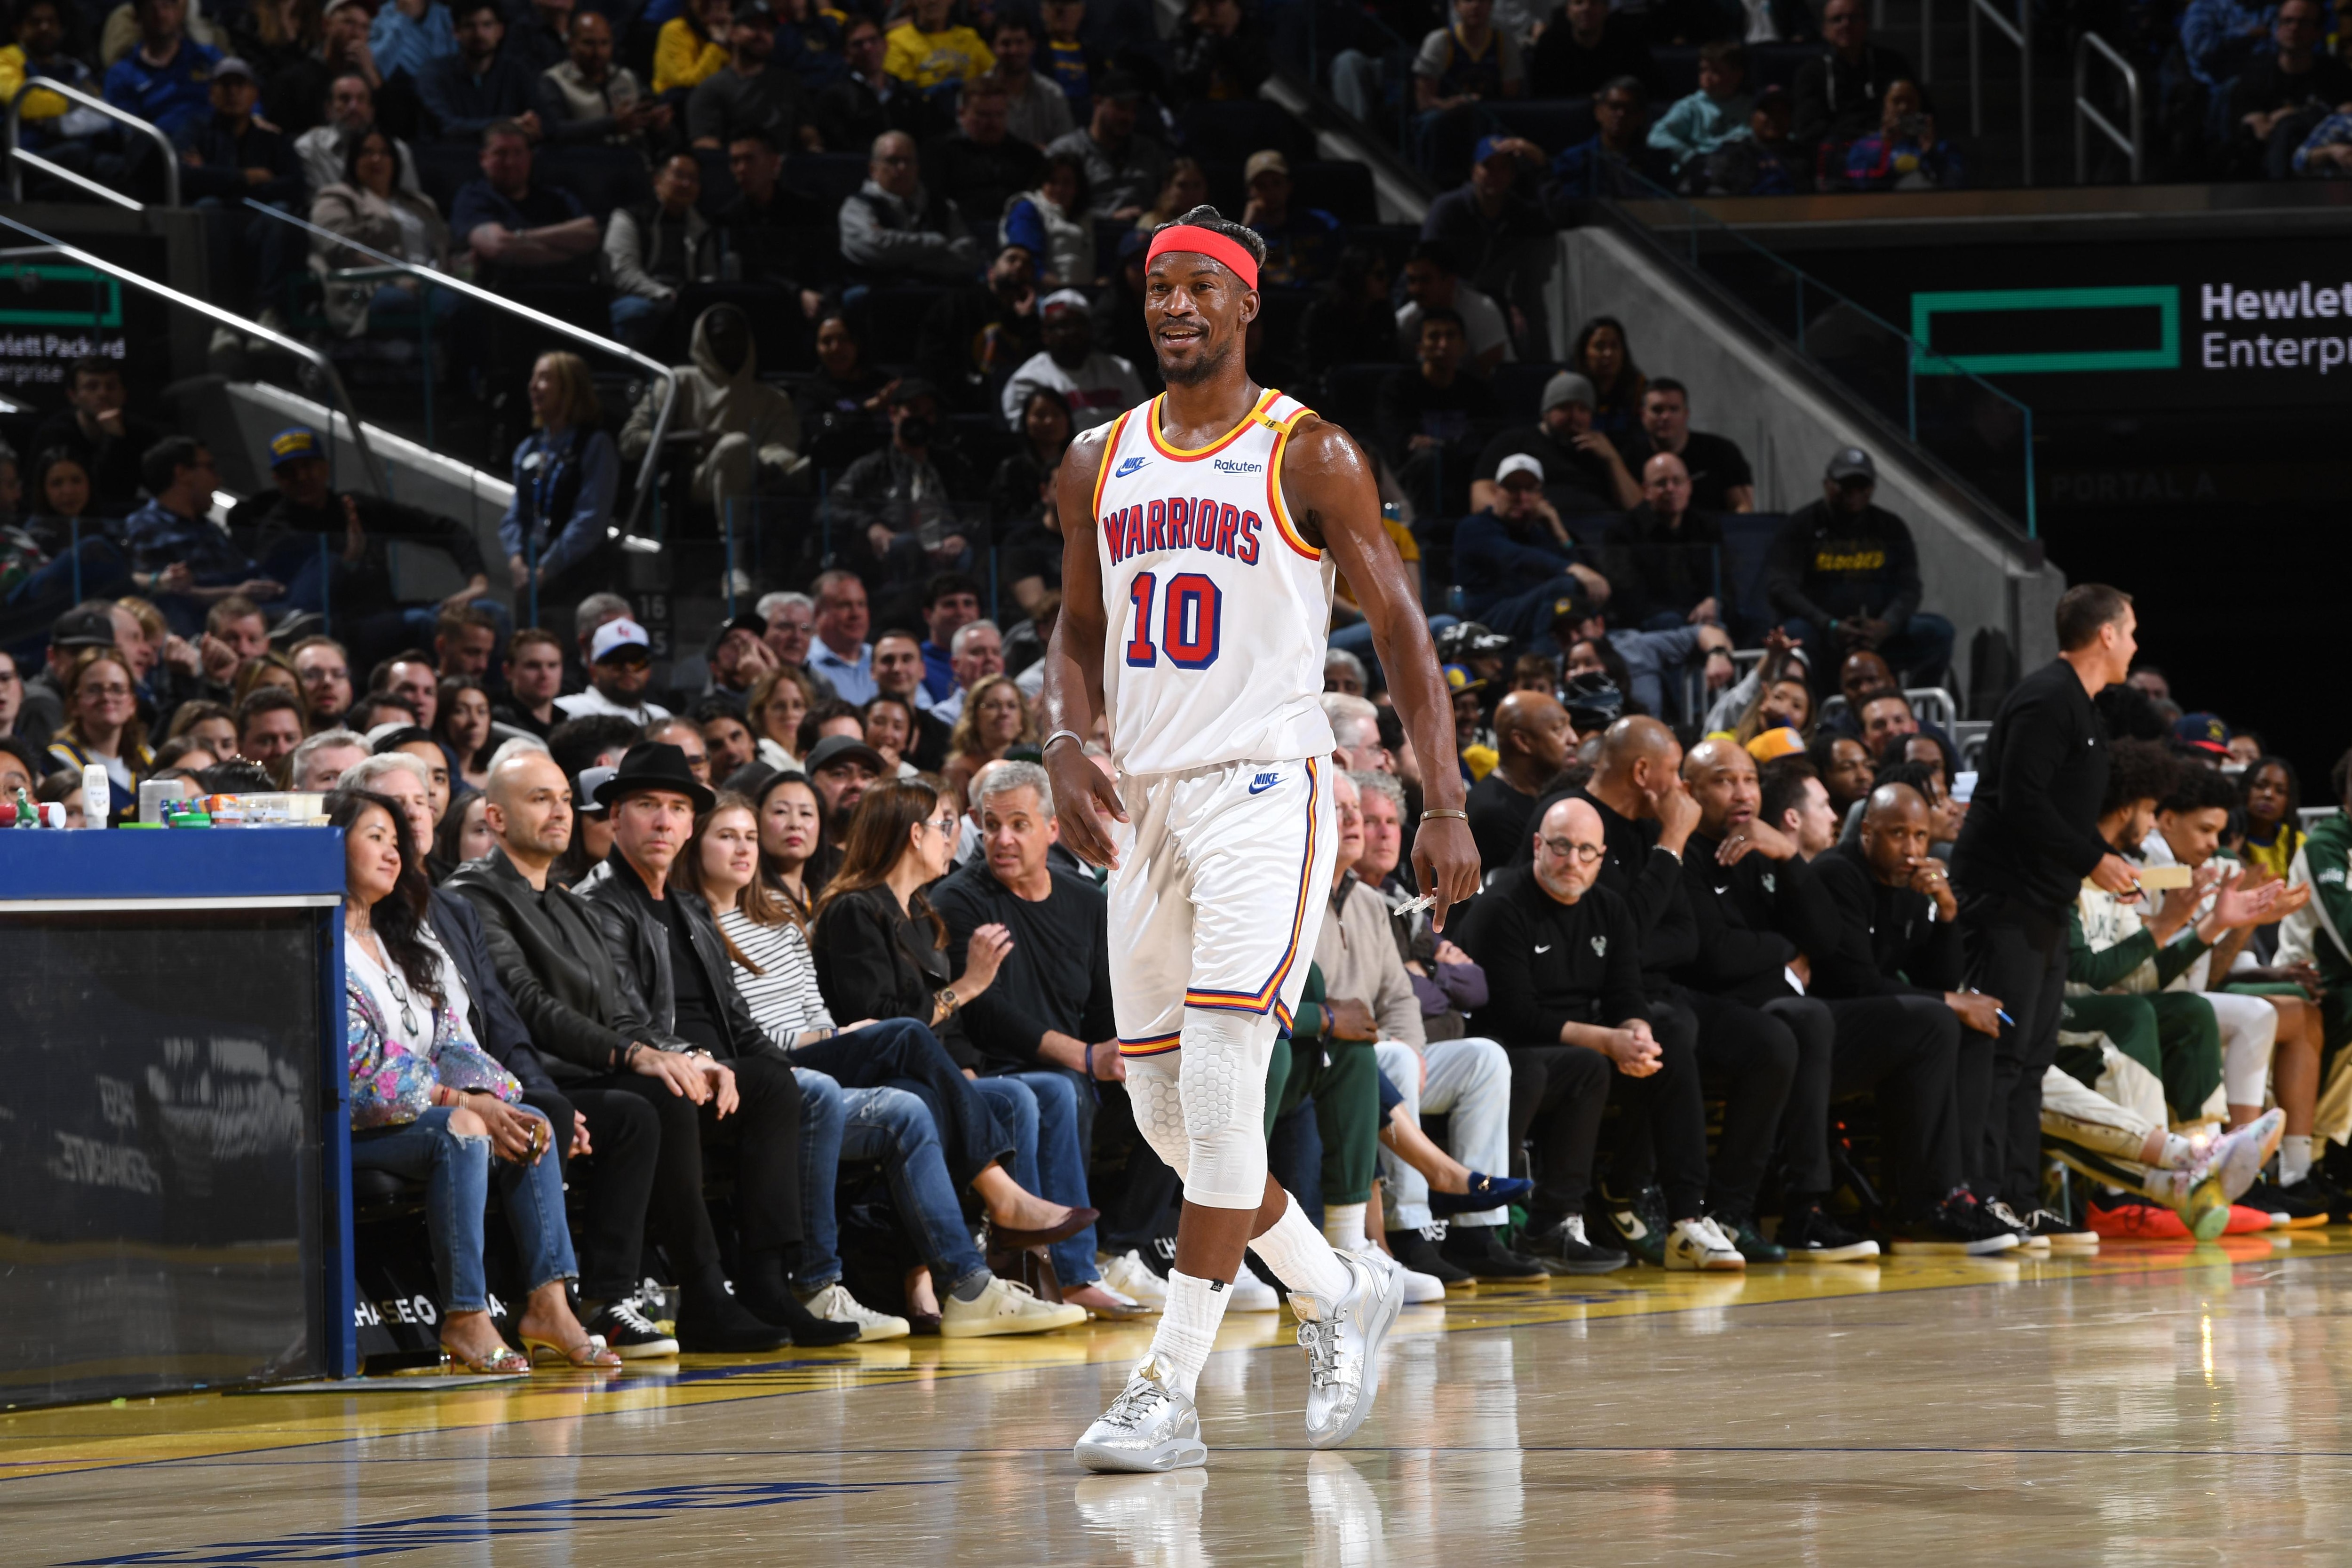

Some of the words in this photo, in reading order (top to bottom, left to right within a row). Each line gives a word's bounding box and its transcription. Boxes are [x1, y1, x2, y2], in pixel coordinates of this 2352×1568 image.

[1264, 419, 1276, 428] 16
[1121, 456, 1145, 470] NIKE
[1214, 459, 1262, 473] Rakuten
[2051, 472, 2183, 501] PORTAL
[2193, 470, 2218, 499] A
[1103, 497, 1262, 567] WARRIORS
[638, 595, 666, 620] 16
[1126, 571, 1223, 670] 10
[1253, 772, 1279, 785] NIKE
[354, 1298, 418, 1327] HASE
[43, 1480, 965, 1568] ENTER
